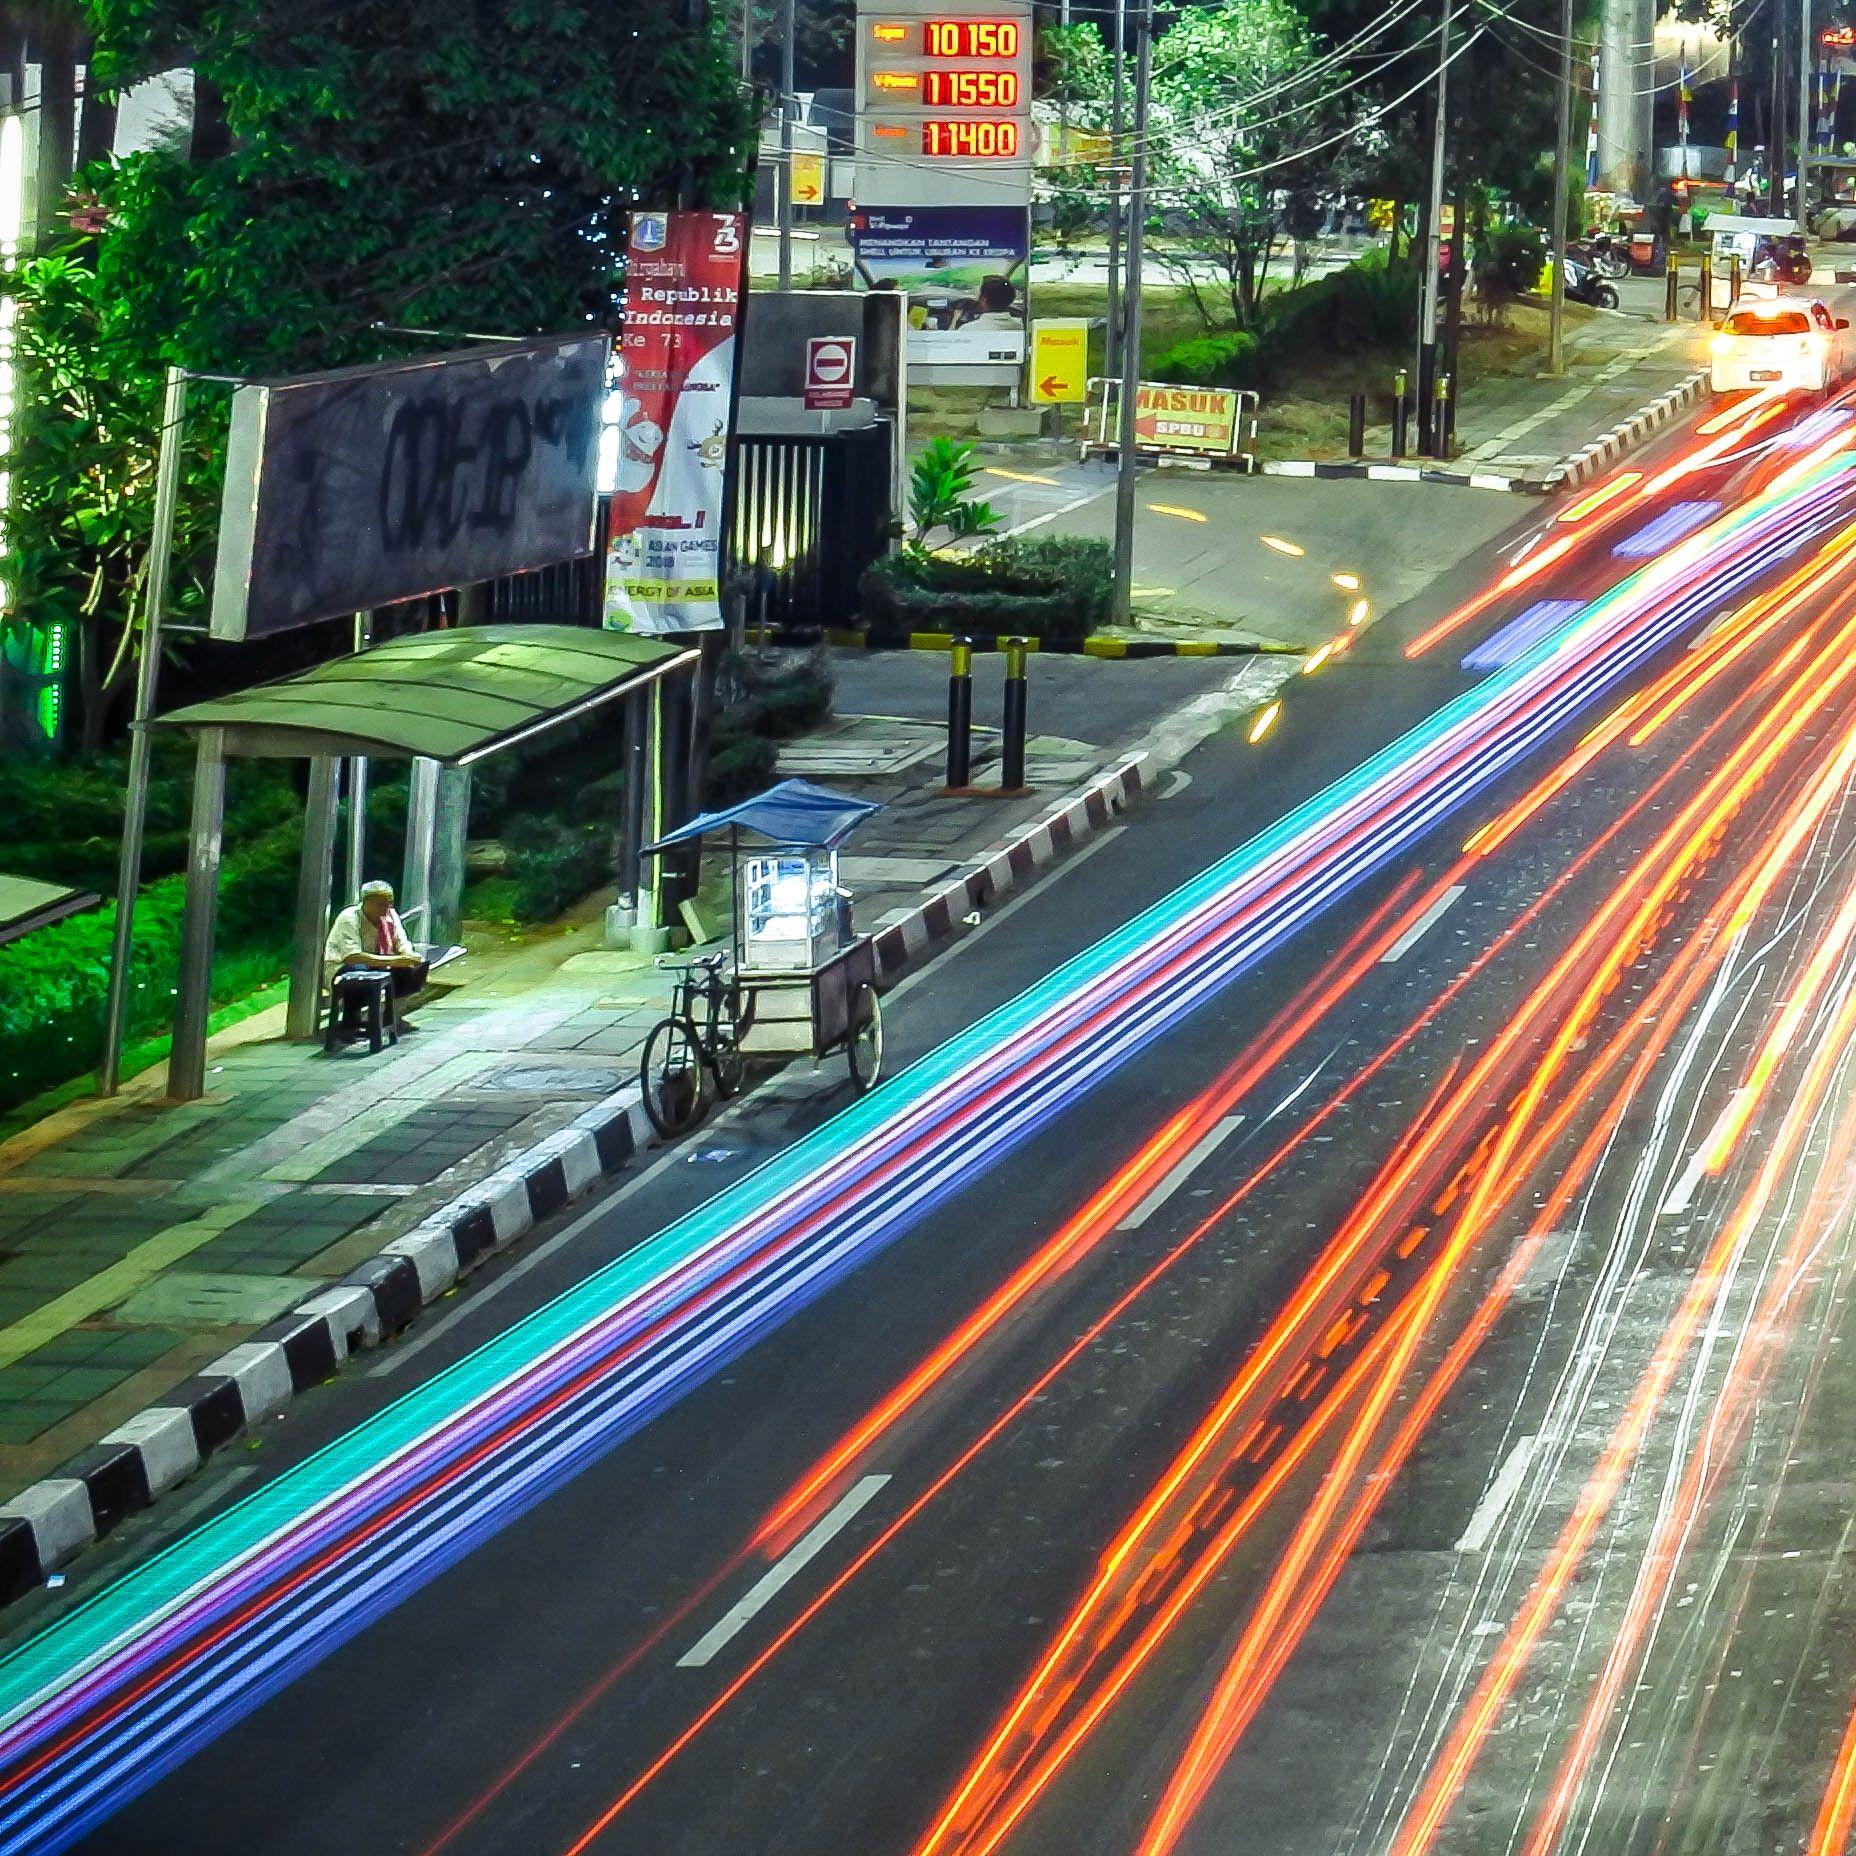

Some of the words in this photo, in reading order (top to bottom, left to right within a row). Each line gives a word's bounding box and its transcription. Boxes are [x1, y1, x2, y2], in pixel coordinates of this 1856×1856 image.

[641, 286, 738, 305] Republik
[625, 309, 733, 326] Indonesia
[622, 333, 646, 347] Ke
[1136, 389, 1225, 414] MASUK
[684, 586, 715, 597] ASIA
